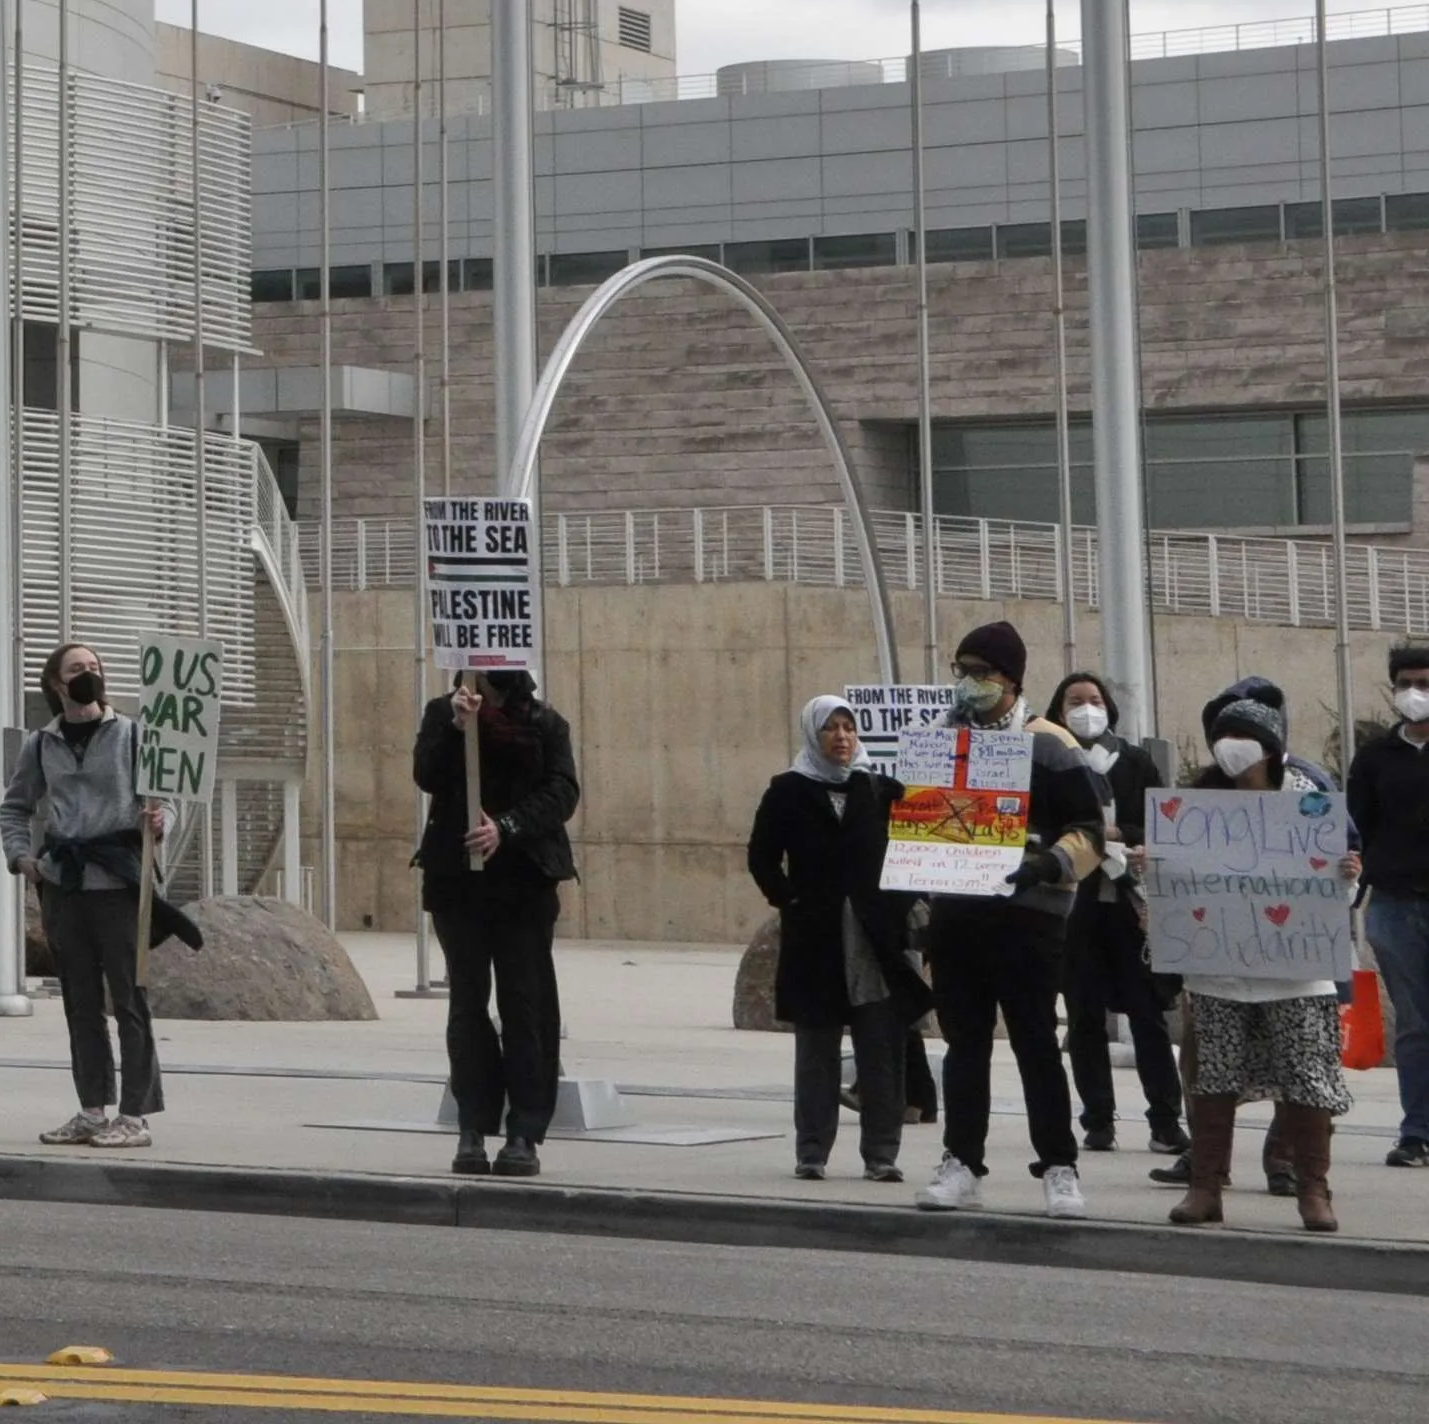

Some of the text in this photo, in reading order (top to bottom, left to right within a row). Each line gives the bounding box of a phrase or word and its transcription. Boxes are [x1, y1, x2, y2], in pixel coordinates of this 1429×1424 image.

[450, 501, 478, 521] THE
[484, 501, 529, 521] RIVER
[426, 524, 528, 554] TO THE SEA
[430, 589, 531, 620] PALESTINE
[456, 624, 480, 648] BE
[487, 624, 533, 648] FREE
[141, 646, 220, 699] O U.S.
[847, 687, 953, 705] FROM THE RIVER
[142, 724, 161, 746] in
[879, 708, 913, 732] THE
[1152, 796, 1341, 873] Long Live
[1148, 857, 1341, 899] Internationa
[1162, 901, 1342, 976] Solidarity
